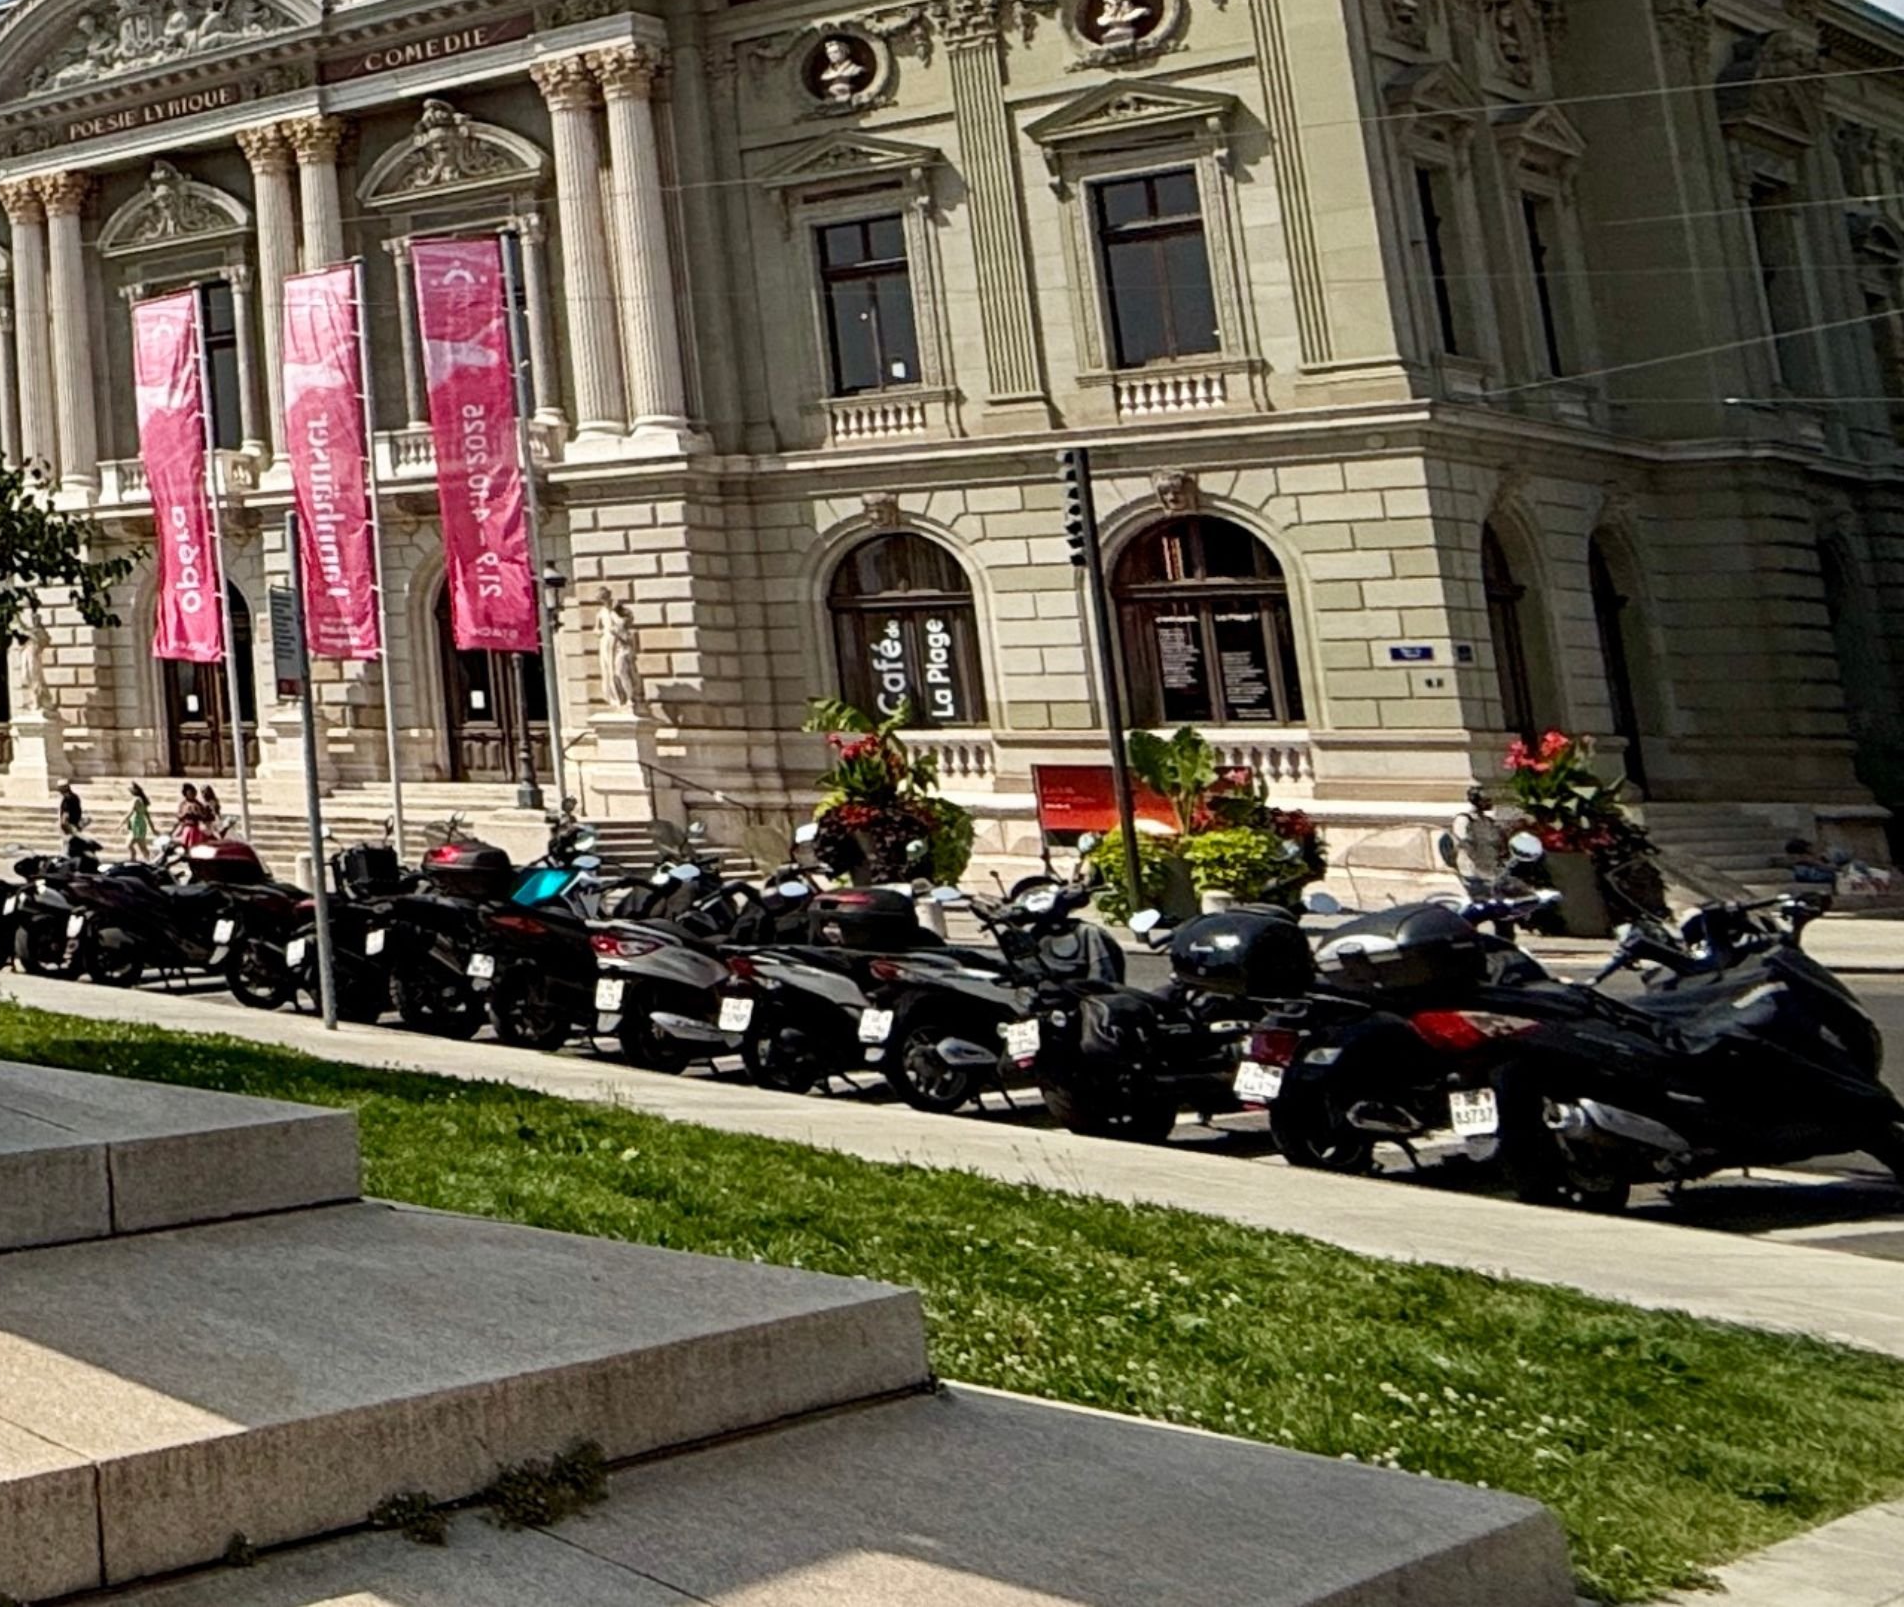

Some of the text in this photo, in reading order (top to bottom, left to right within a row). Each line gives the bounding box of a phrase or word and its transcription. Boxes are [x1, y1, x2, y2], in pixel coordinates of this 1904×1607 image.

[364, 26, 489, 71] COMEDIE
[69, 88, 230, 141] POESIE LYRIQUE
[870, 619, 907, 716] Café de
[925, 619, 954, 717] La Plage
